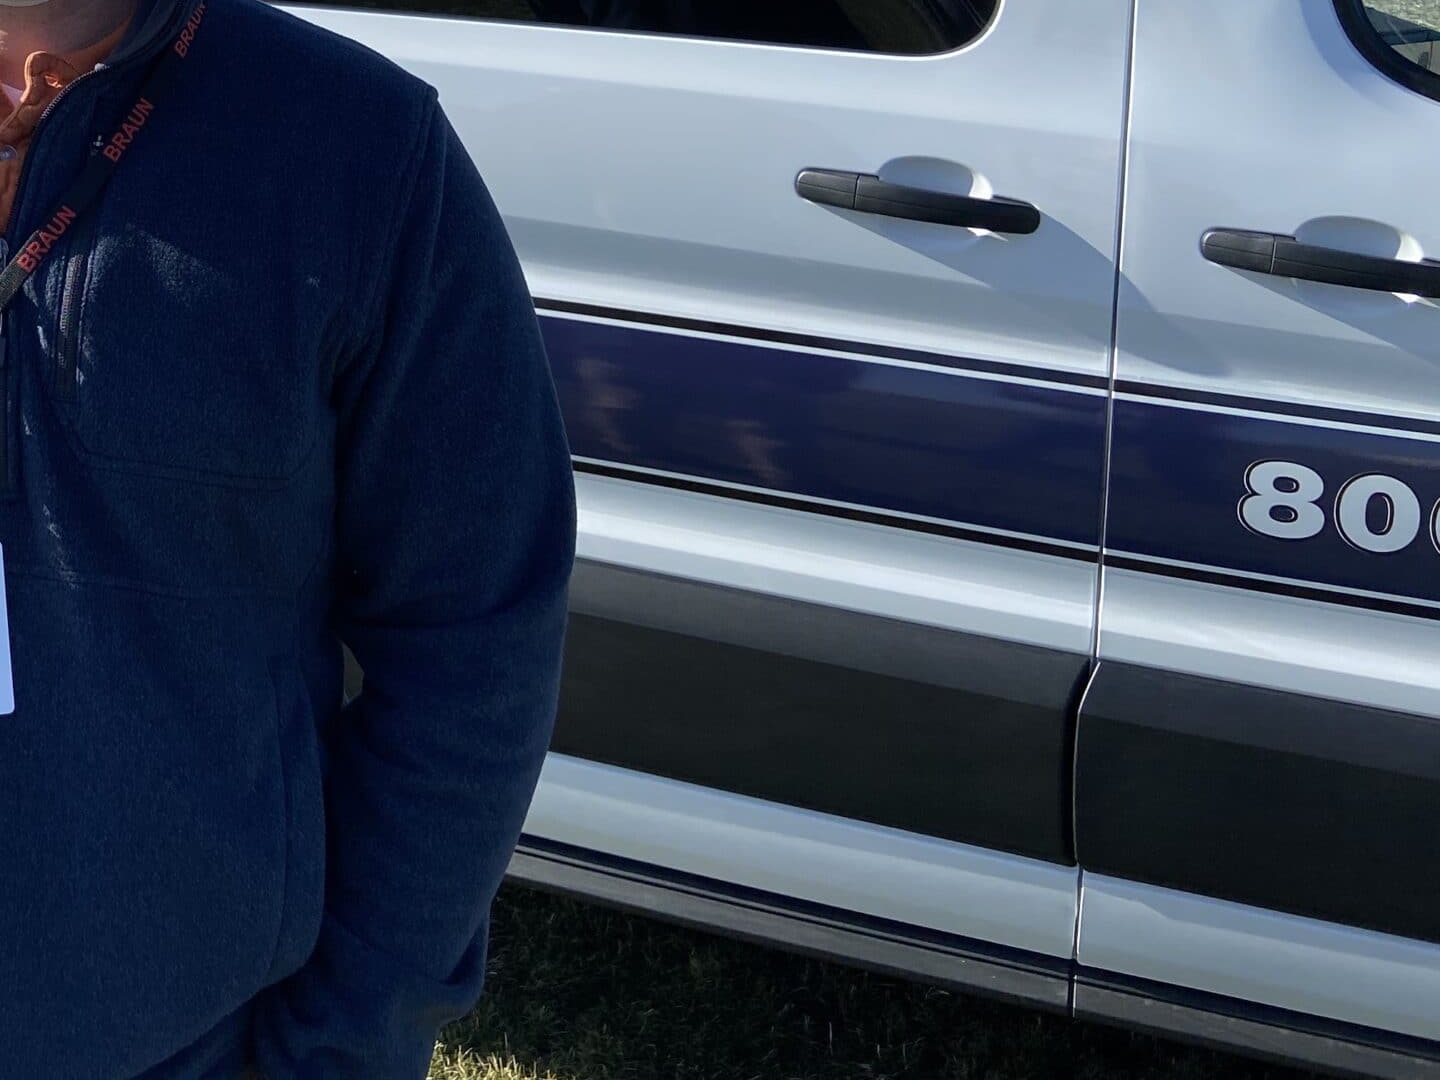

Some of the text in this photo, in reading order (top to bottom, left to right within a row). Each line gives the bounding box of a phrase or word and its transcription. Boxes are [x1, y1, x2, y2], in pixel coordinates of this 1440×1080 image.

[103, 97, 156, 163] BRAUN
[16, 205, 77, 272] BRAUN
[1237, 458, 1440, 553] 80
